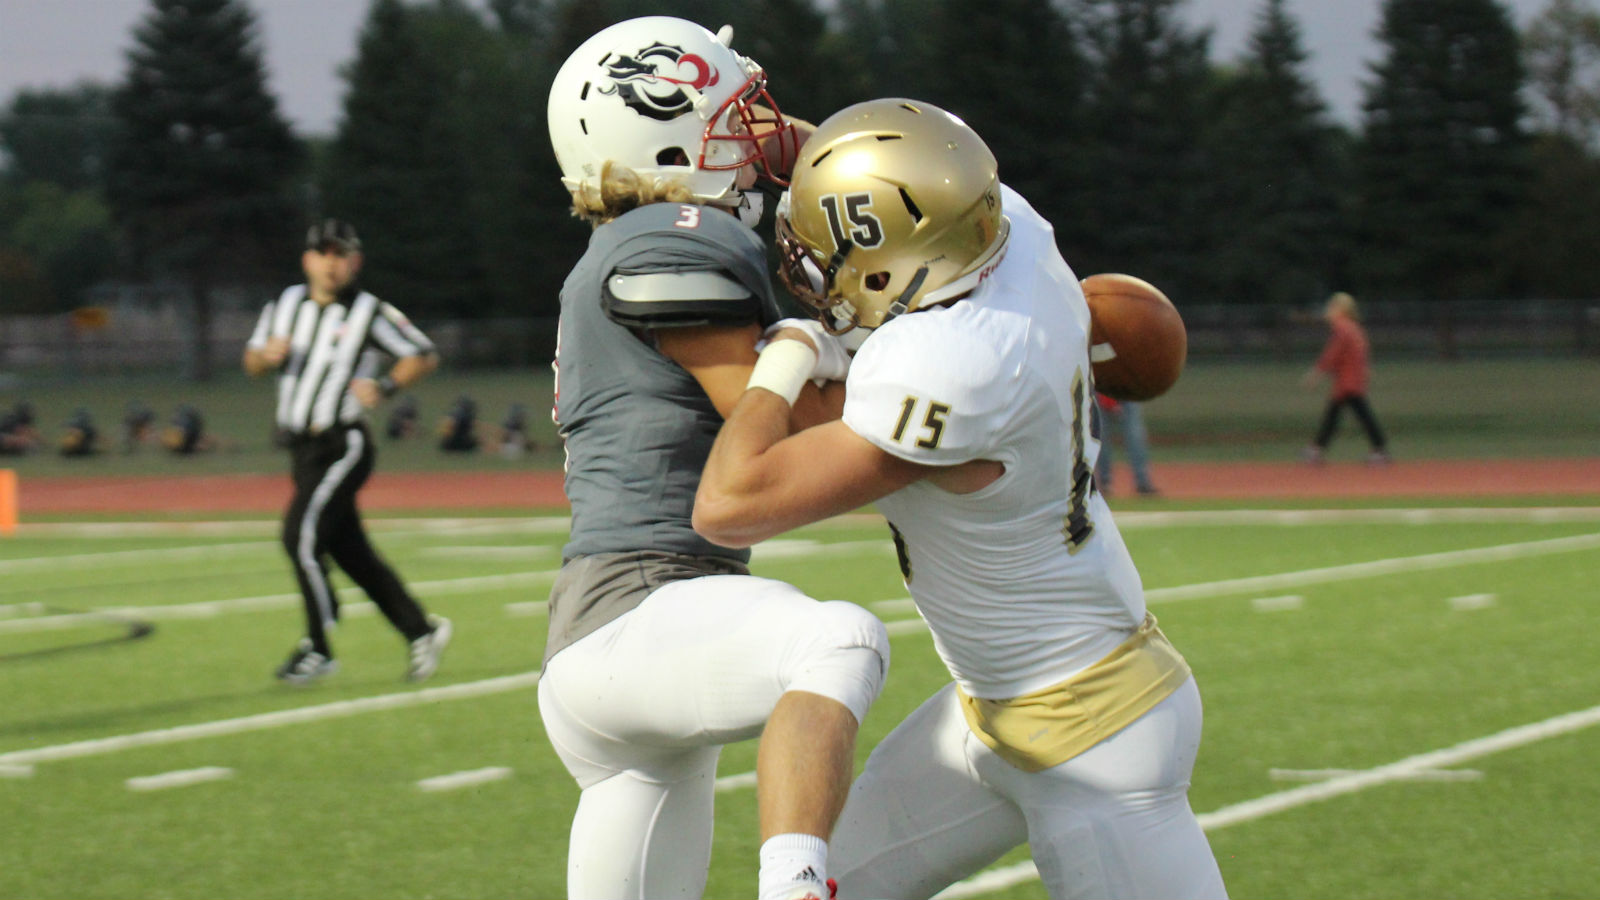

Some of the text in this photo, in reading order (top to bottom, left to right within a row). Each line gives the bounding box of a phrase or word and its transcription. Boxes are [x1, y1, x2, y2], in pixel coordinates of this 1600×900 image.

[674, 204, 700, 228] 3
[819, 191, 885, 250] 15
[890, 395, 952, 450] 15
